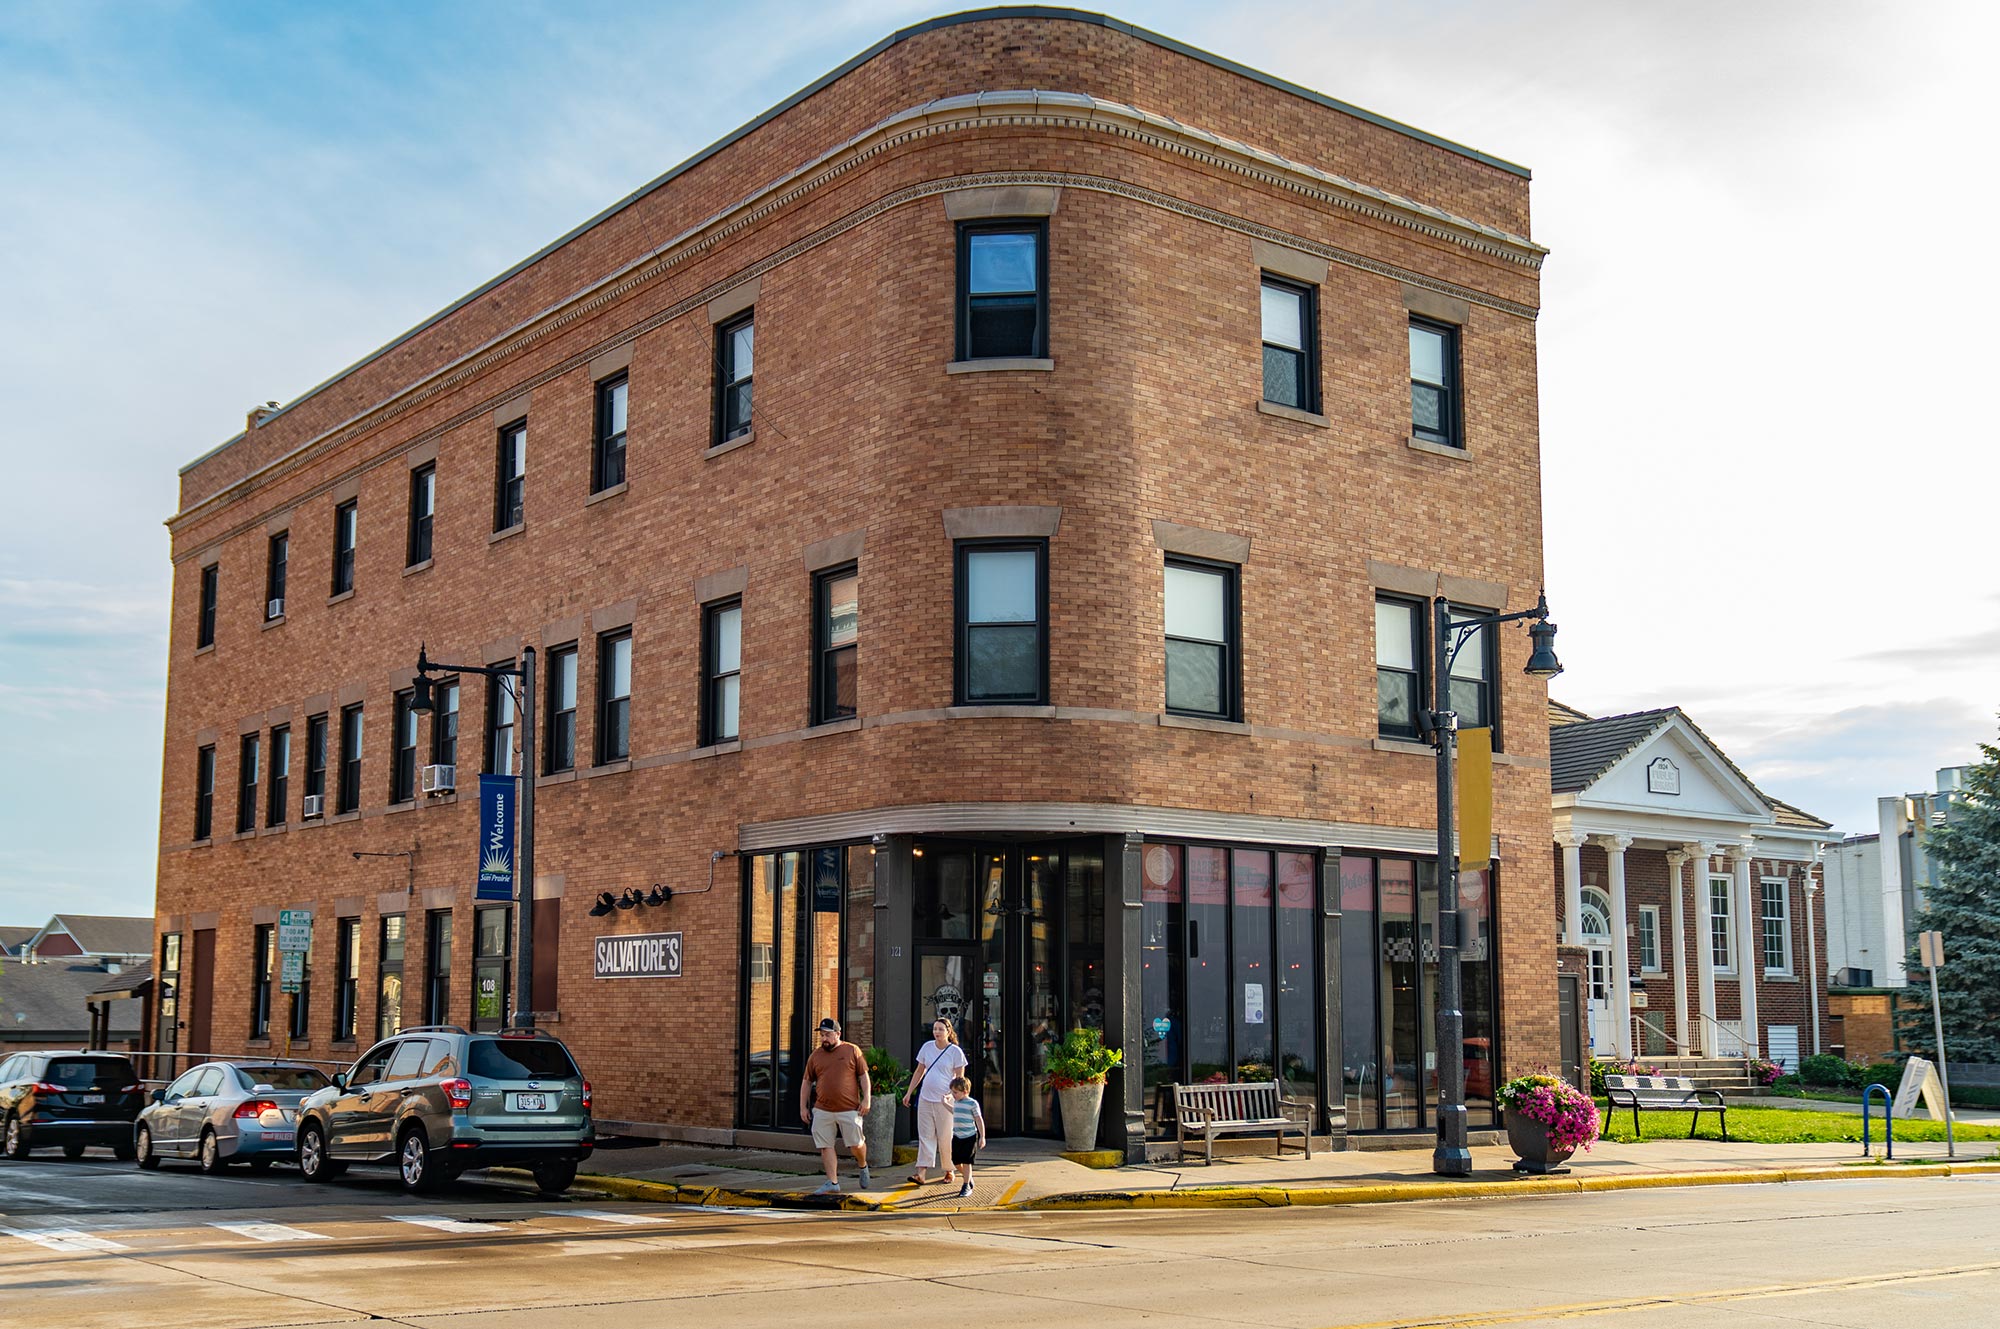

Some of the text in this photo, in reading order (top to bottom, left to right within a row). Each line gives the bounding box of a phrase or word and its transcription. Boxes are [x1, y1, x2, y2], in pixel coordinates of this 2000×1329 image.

[1652, 770, 1675, 780] PUBLIC
[490, 793, 504, 850] Welcome
[480, 873, 510, 882] Sun Prairie
[281, 912, 289, 924] 4
[597, 937, 679, 973] SALVATORE'S
[482, 979, 496, 992] 108
